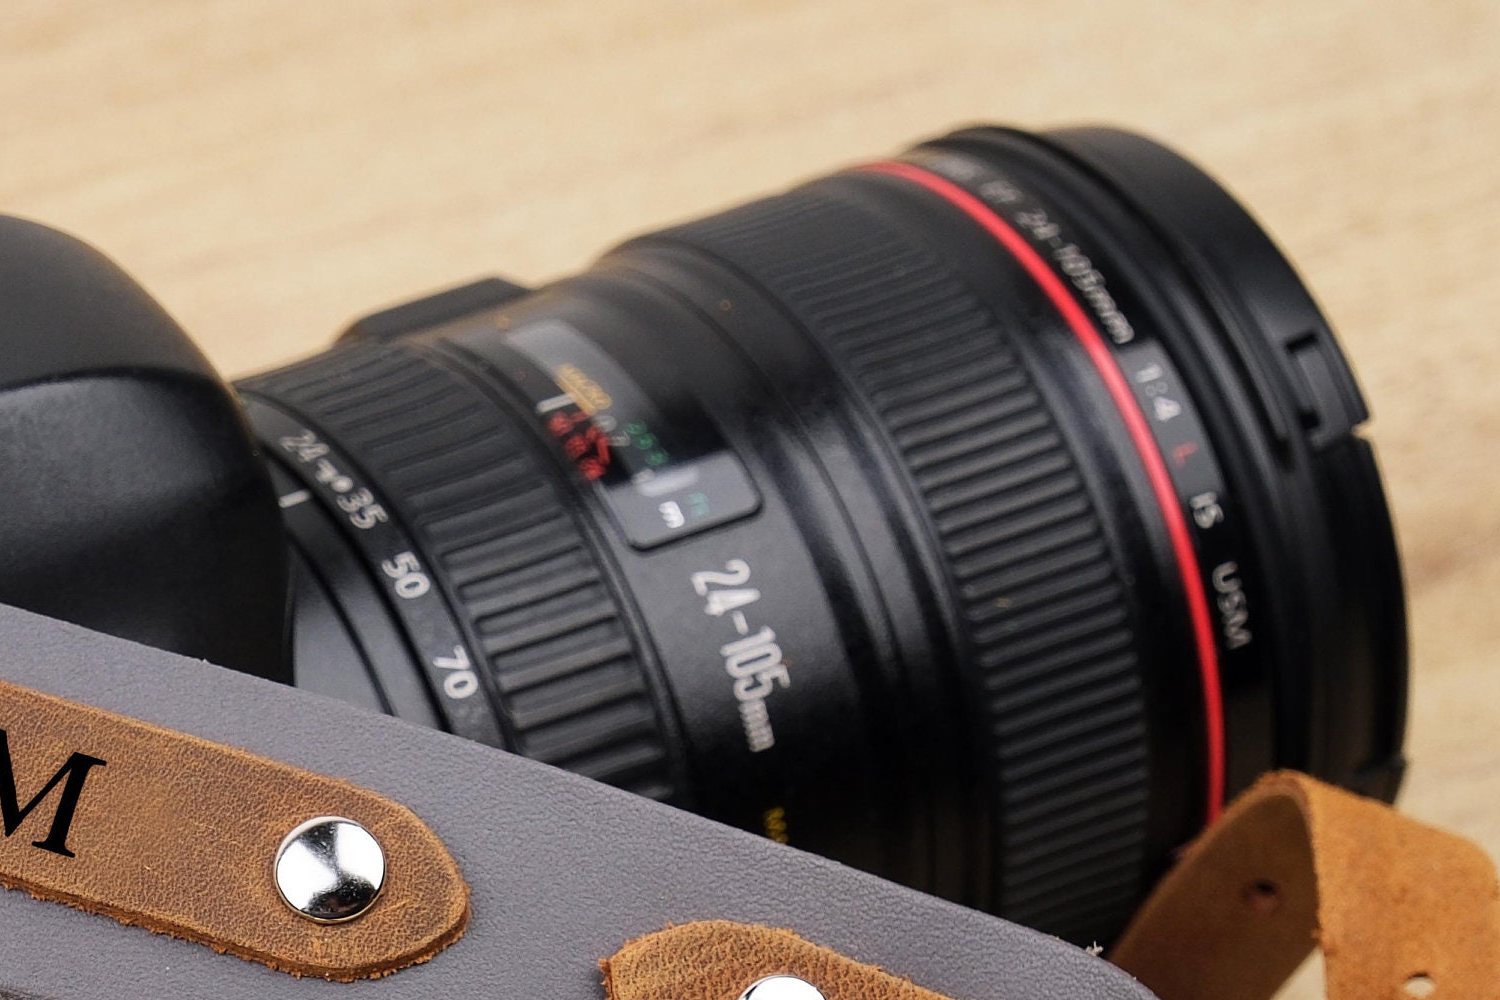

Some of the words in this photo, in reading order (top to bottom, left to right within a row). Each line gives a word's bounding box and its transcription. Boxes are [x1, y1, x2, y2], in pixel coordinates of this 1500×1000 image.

[336, 486, 389, 530] 35
[381, 550, 431, 599] 50
[1189, 491, 1225, 529] IS
[1211, 560, 1253, 650] USM
[432, 644, 479, 700] 70
[690, 558, 791, 752] 24-105mm
